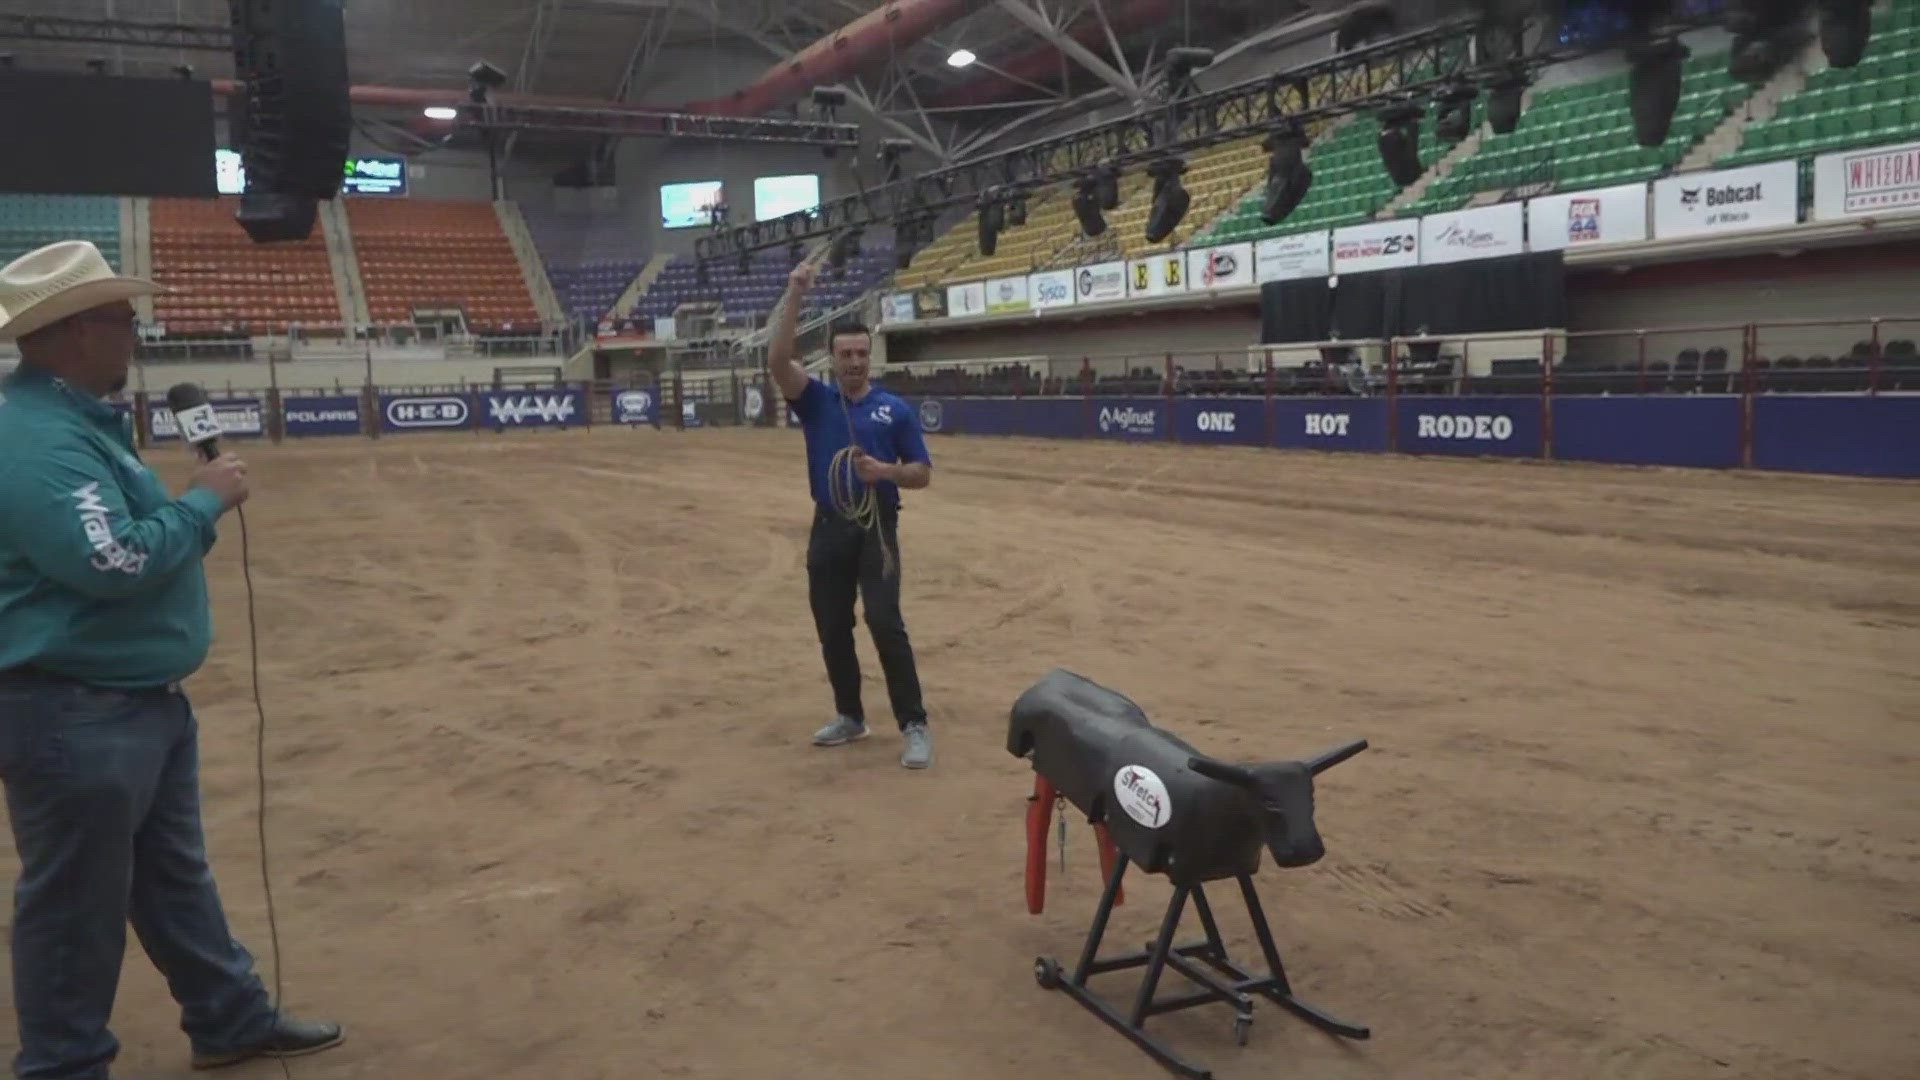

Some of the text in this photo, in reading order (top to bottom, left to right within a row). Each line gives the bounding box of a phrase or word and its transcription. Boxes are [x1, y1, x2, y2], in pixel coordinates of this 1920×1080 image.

[1706, 182, 1762, 207] Bobcat
[286, 410, 357, 422] POLARIS
[1197, 412, 1236, 432] ONE
[1305, 413, 1350, 436] HOT
[1417, 415, 1513, 440] RODEO
